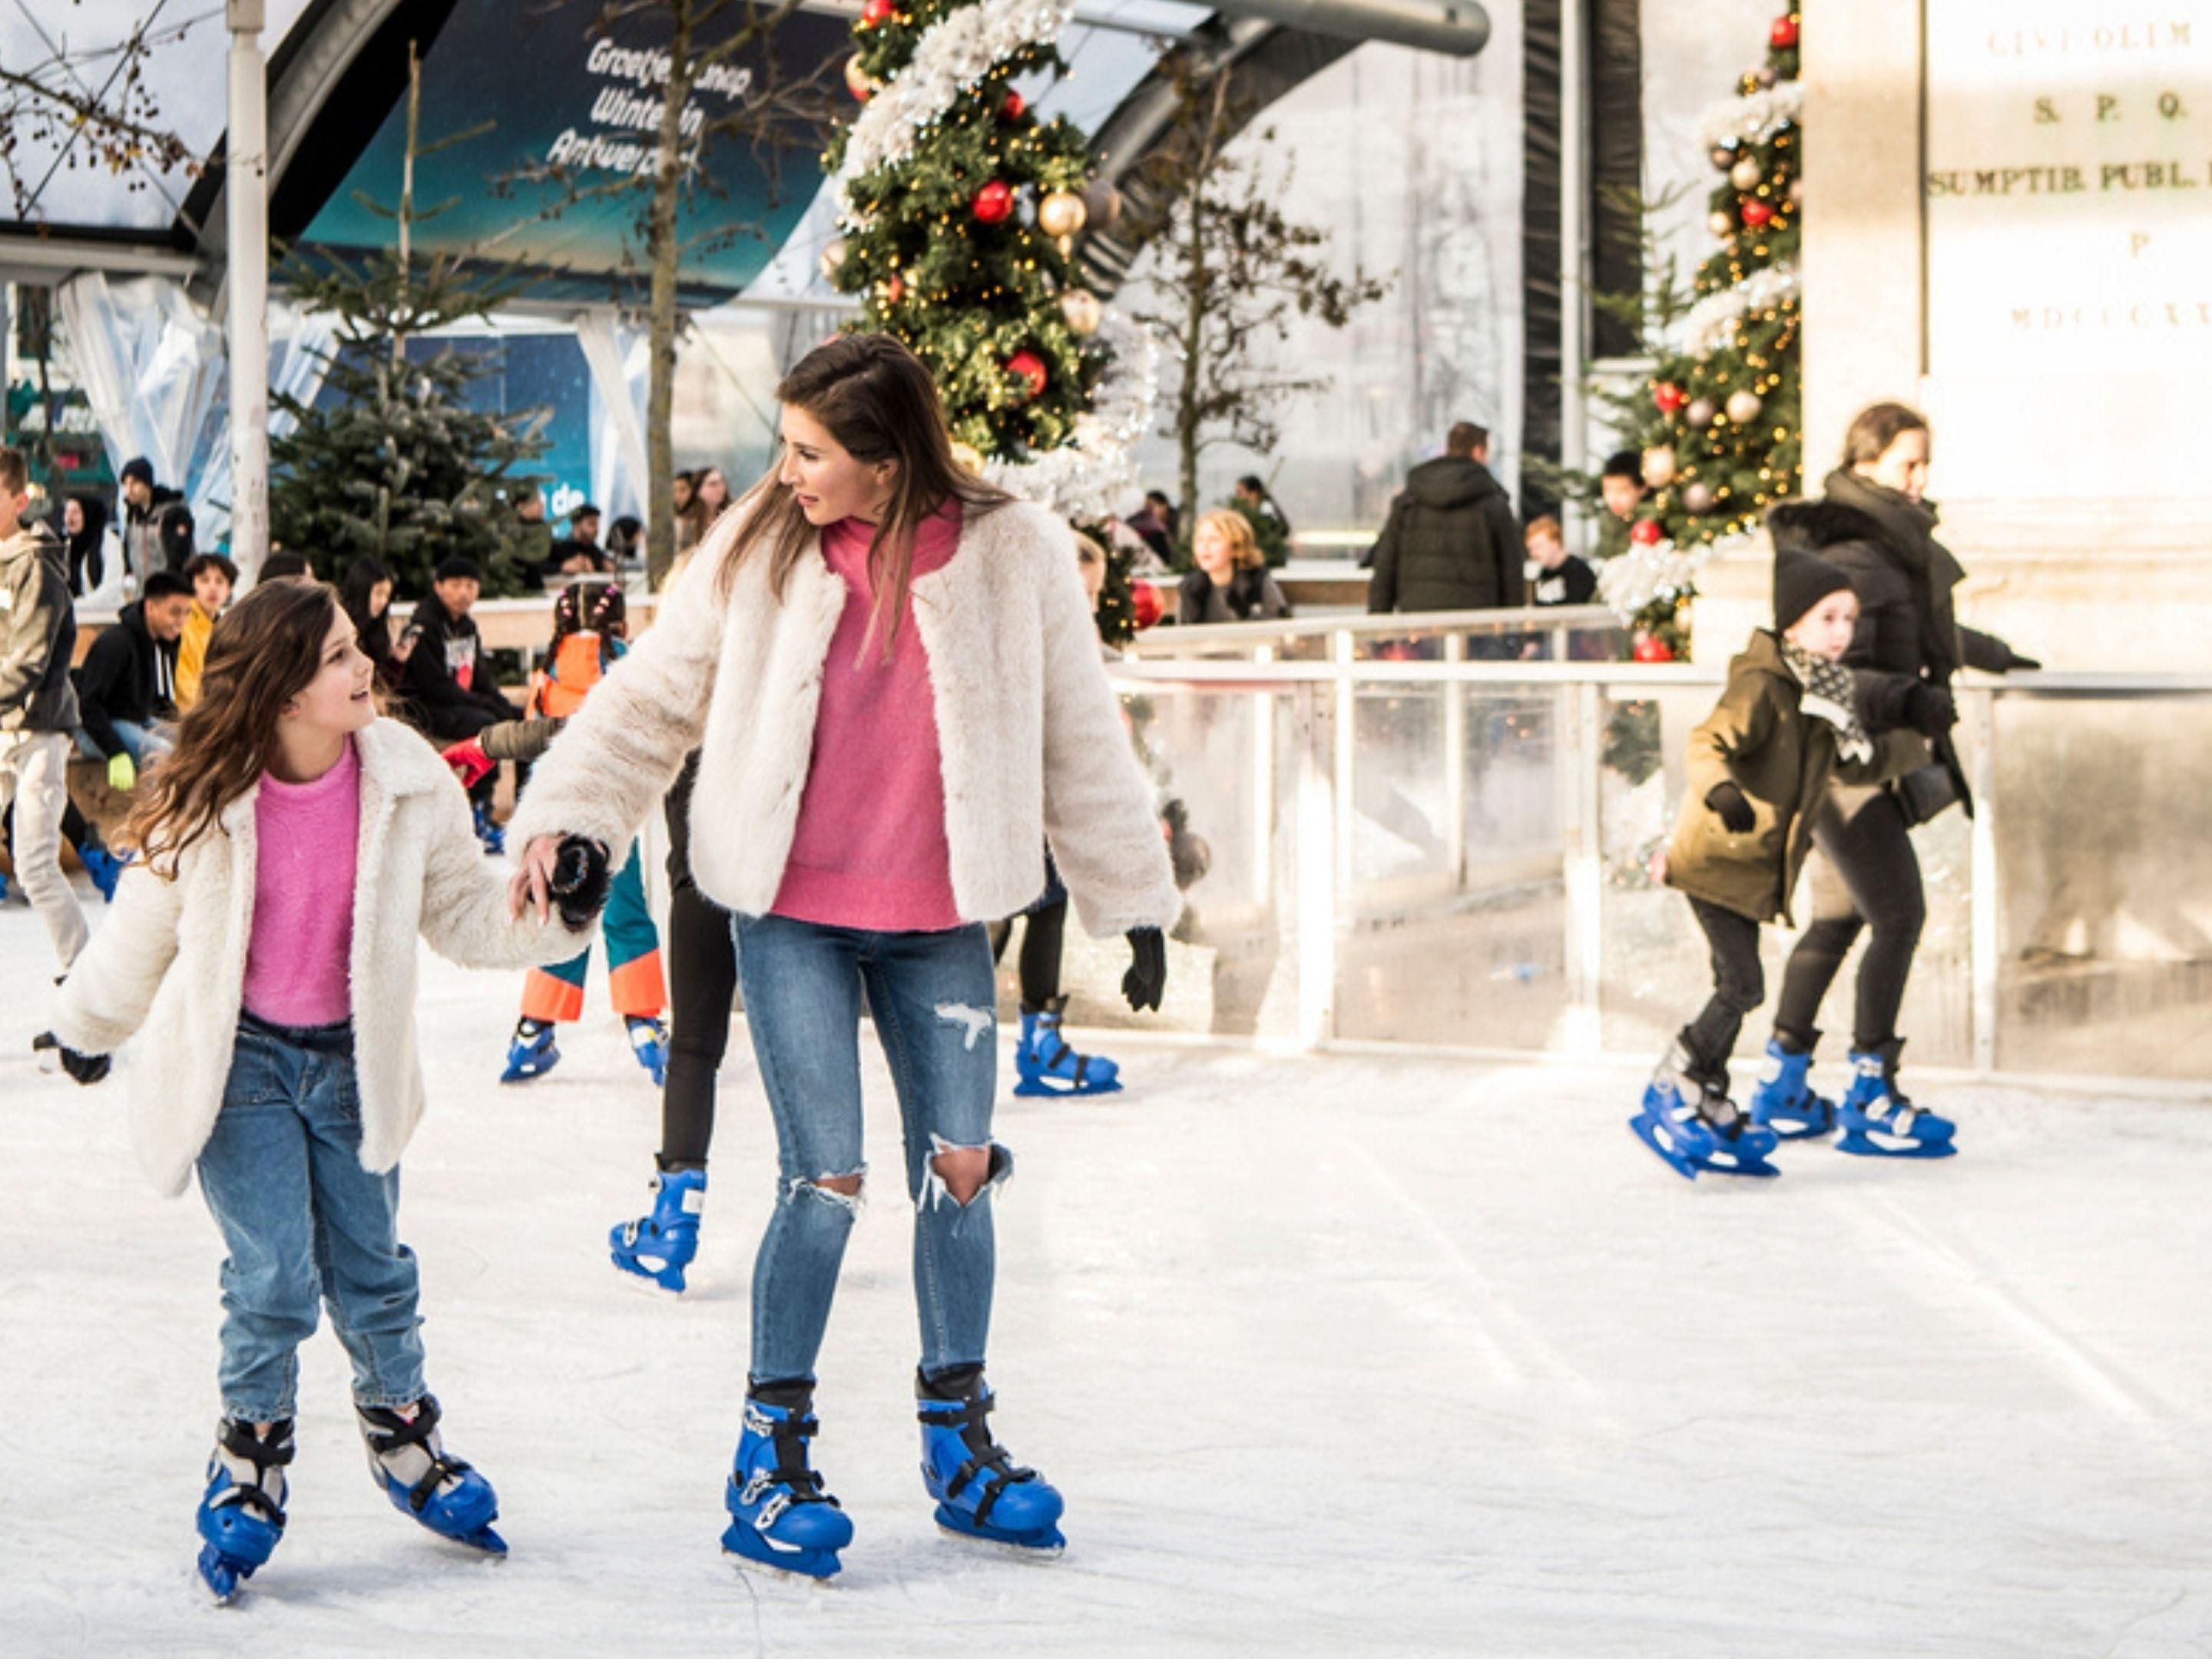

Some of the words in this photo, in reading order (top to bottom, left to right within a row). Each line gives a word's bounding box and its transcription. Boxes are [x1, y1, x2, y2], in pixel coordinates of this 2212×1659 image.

[587, 36, 680, 88] Groetje
[590, 84, 673, 132] Winte
[679, 97, 704, 137] in
[546, 127, 695, 177] Antwerp
